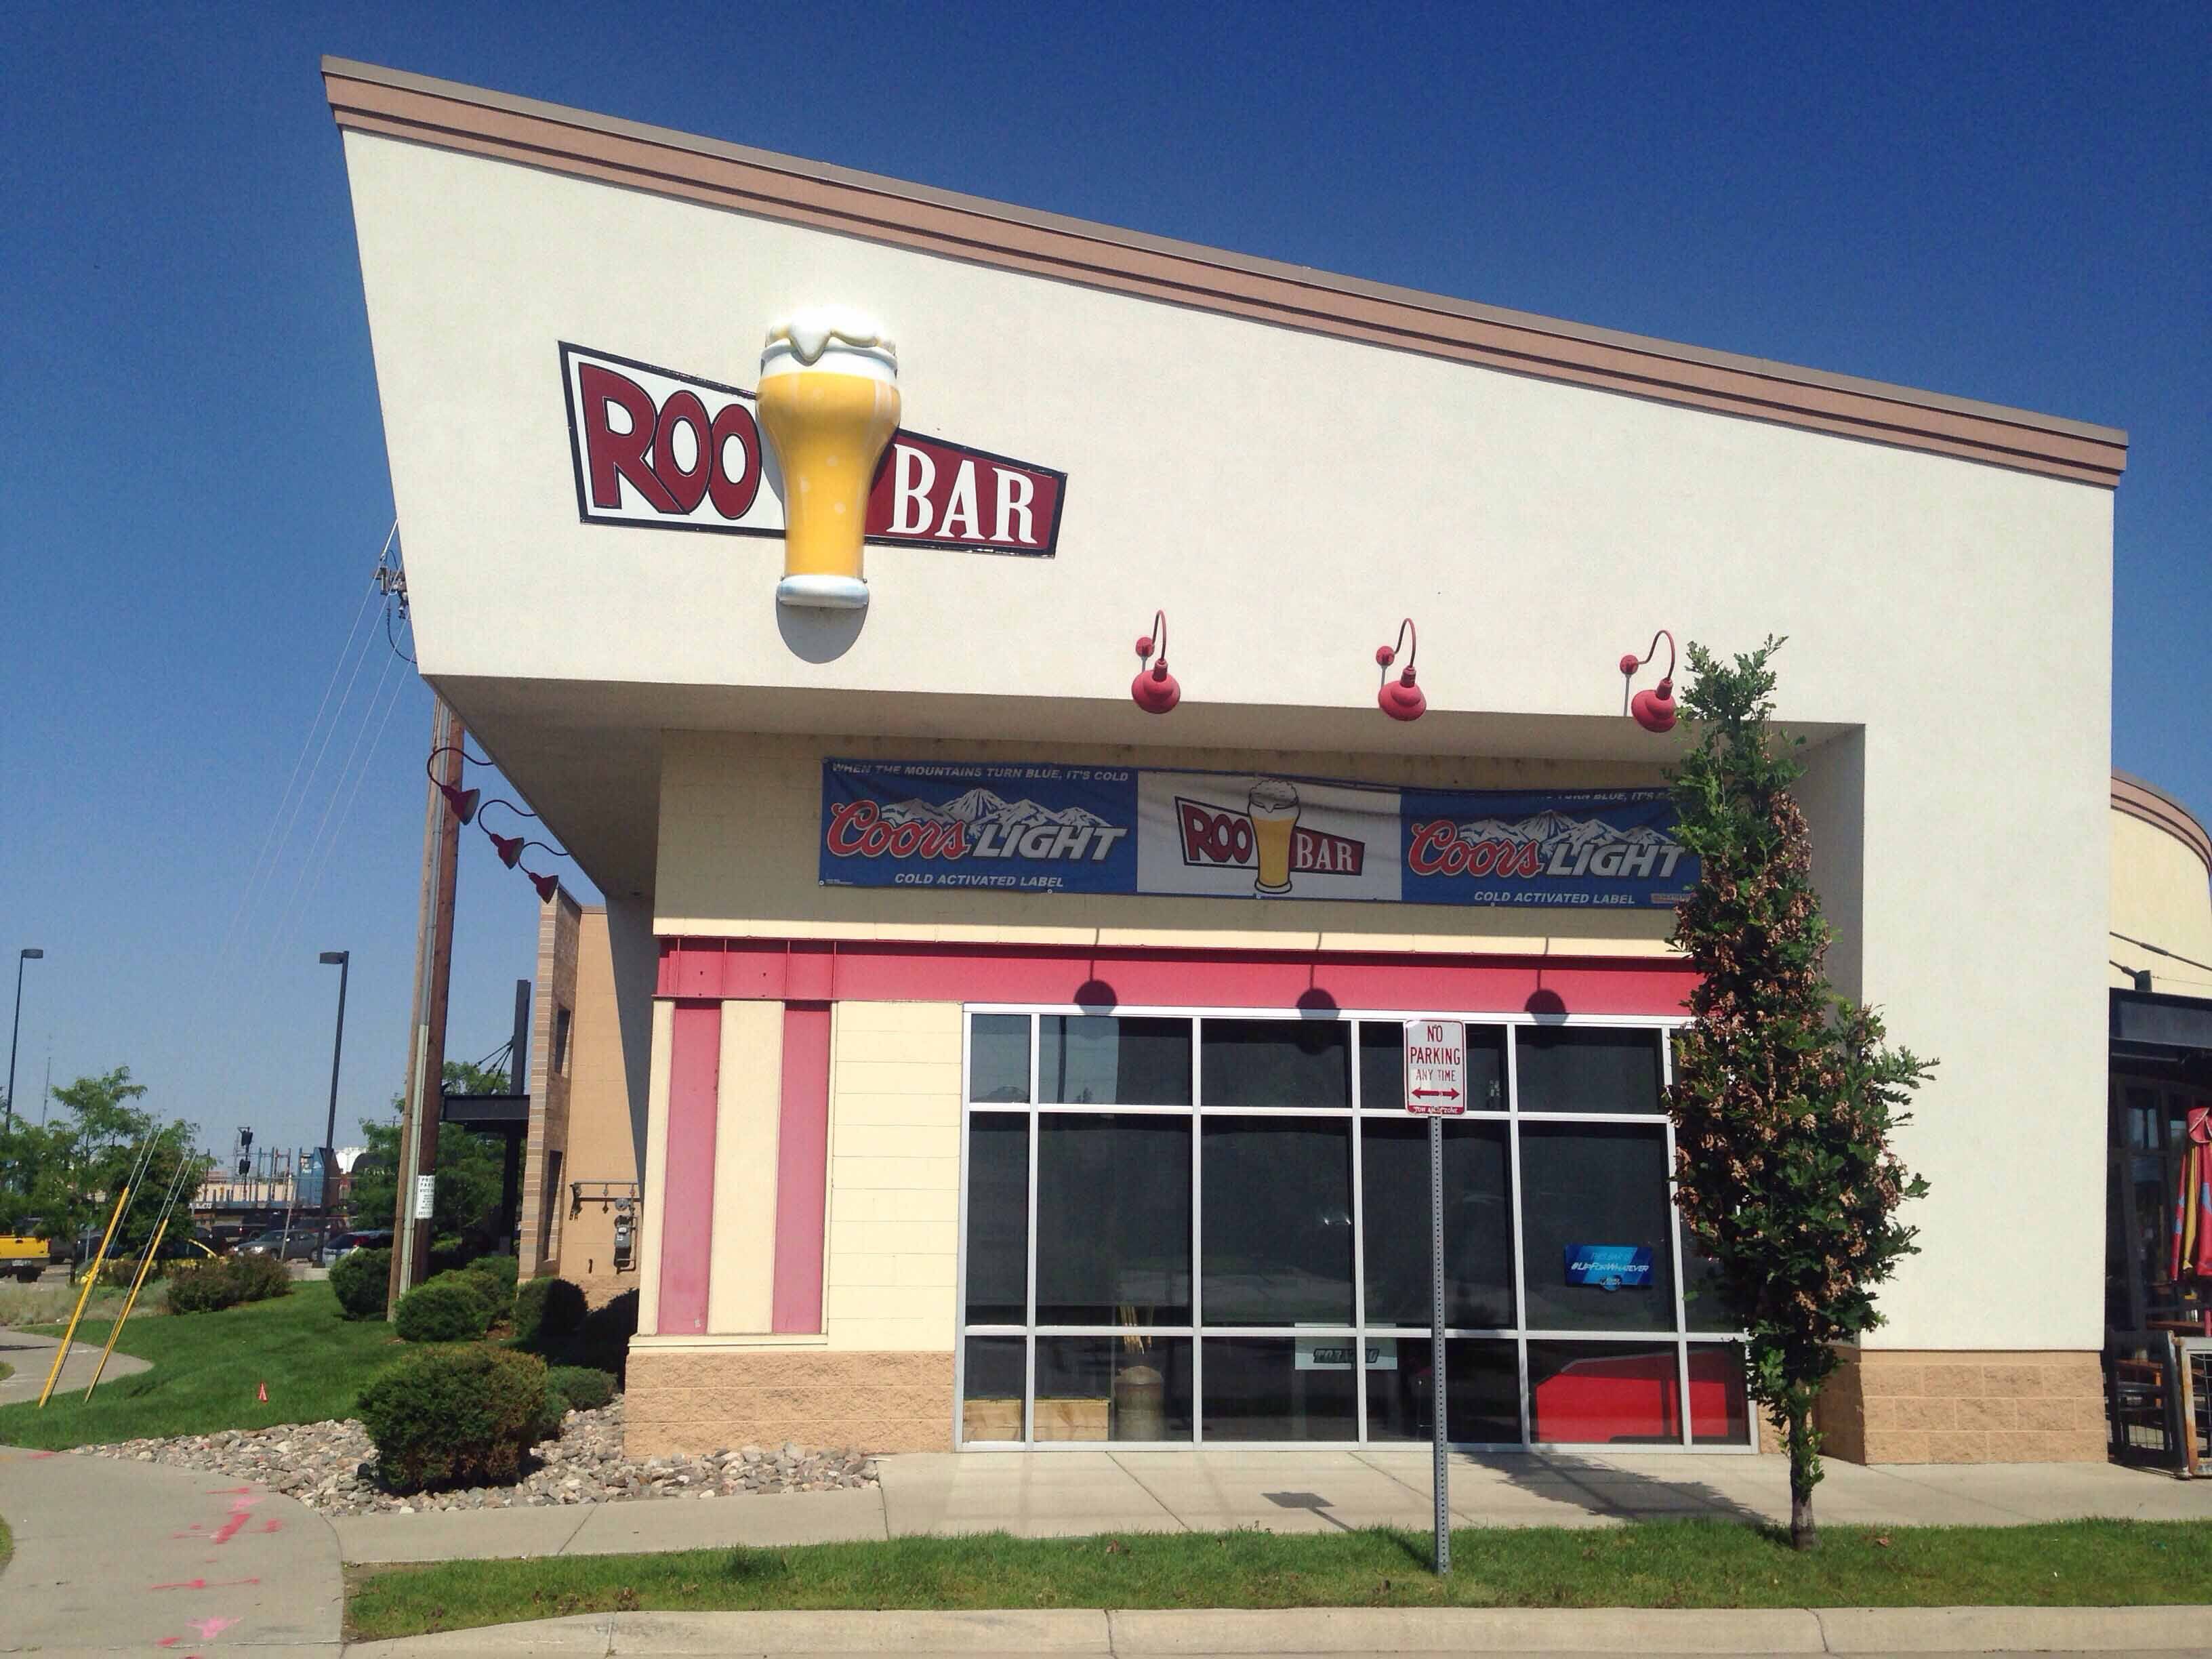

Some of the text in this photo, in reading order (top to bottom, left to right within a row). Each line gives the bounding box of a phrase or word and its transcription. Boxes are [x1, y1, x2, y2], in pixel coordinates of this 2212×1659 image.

[579, 362, 1038, 544] ROO BAR
[832, 764, 1128, 781] WHEN THE MOUNTAINS TURN BLUE, IT'S COLD
[827, 800, 1128, 861] Coors LIGHT
[1183, 804, 1356, 872] ROO BAR
[1408, 819, 1685, 879] Coors LIGHT
[895, 874, 1063, 887] COLD ACTIVATED LABEL
[1474, 891, 1635, 904] COLD ACTIVATED LABEL
[1427, 1025, 1443, 1042] NO
[1410, 1047, 1460, 1065] PARKING
[1416, 1069, 1456, 1082] ANY TIME
